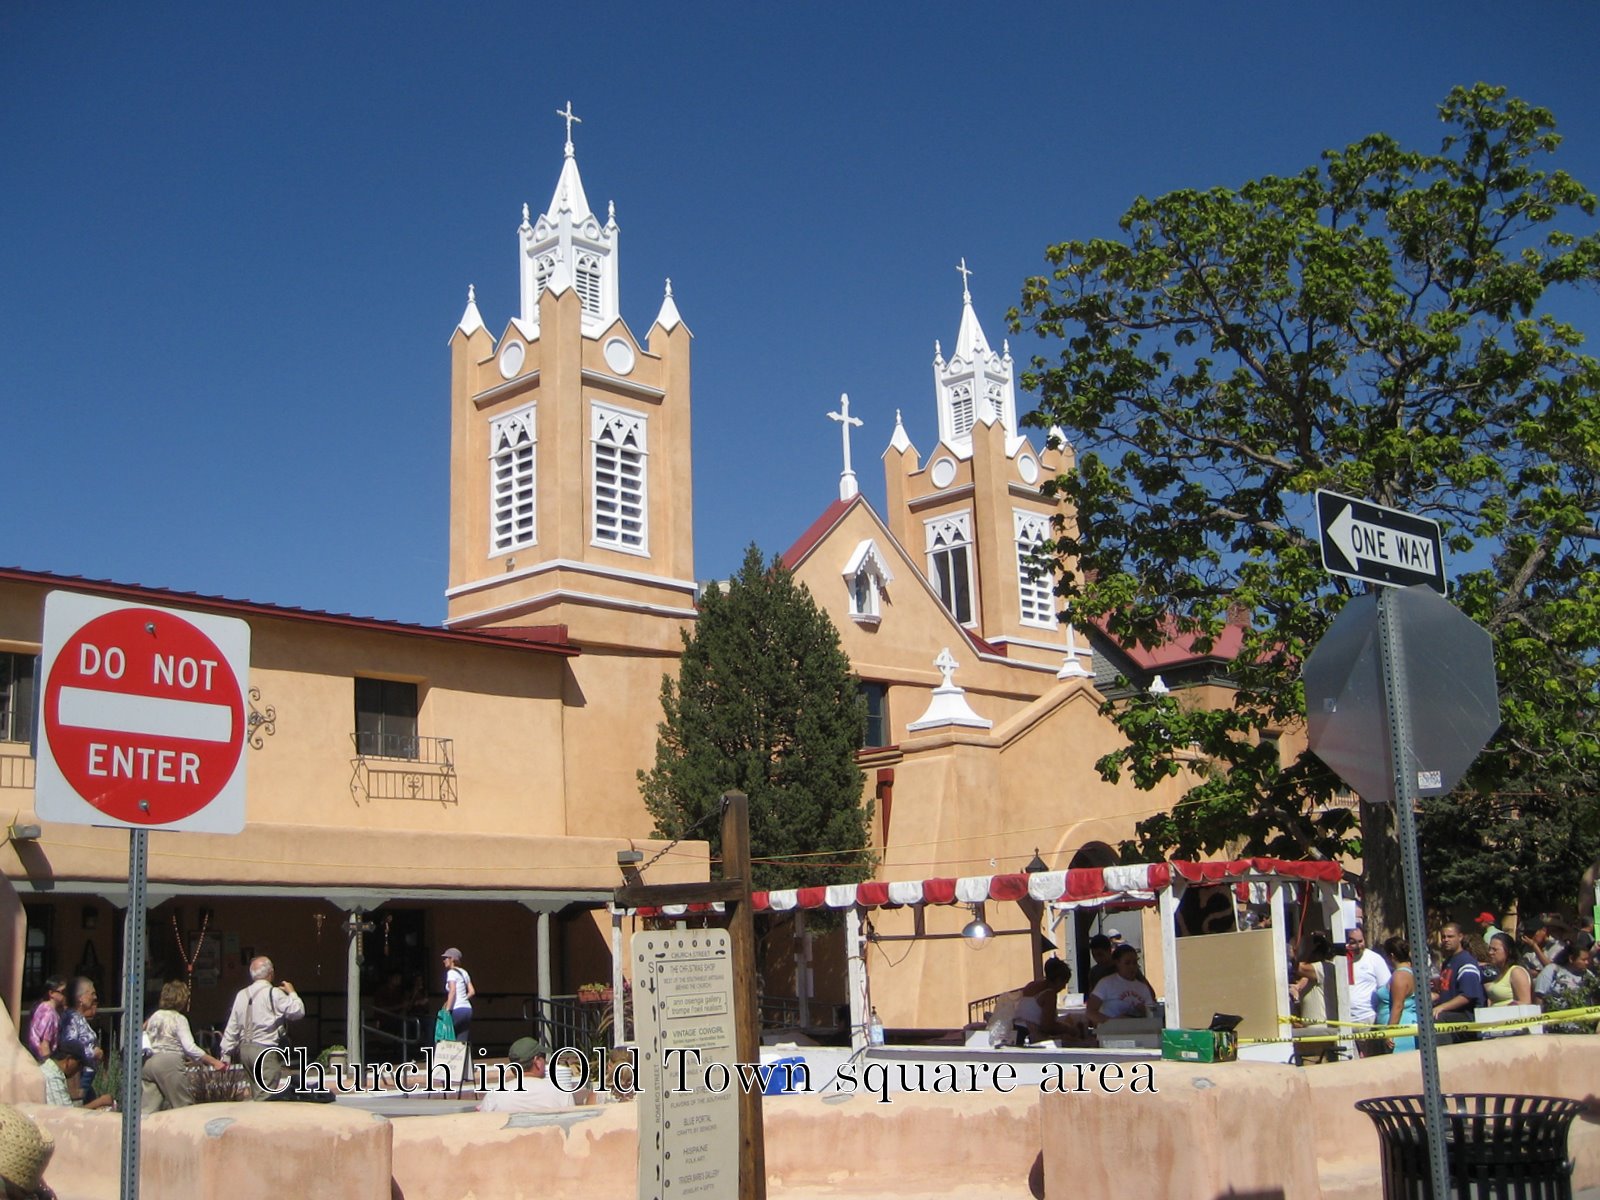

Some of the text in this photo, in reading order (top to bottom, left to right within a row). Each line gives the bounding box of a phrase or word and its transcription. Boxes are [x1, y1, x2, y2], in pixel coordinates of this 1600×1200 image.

[1351, 523, 1431, 570] ONE WAY
[79, 642, 218, 690] DO NOT
[88, 743, 201, 785] ENTER
[672, 1026, 724, 1037] VINTAGE COWGIRL
